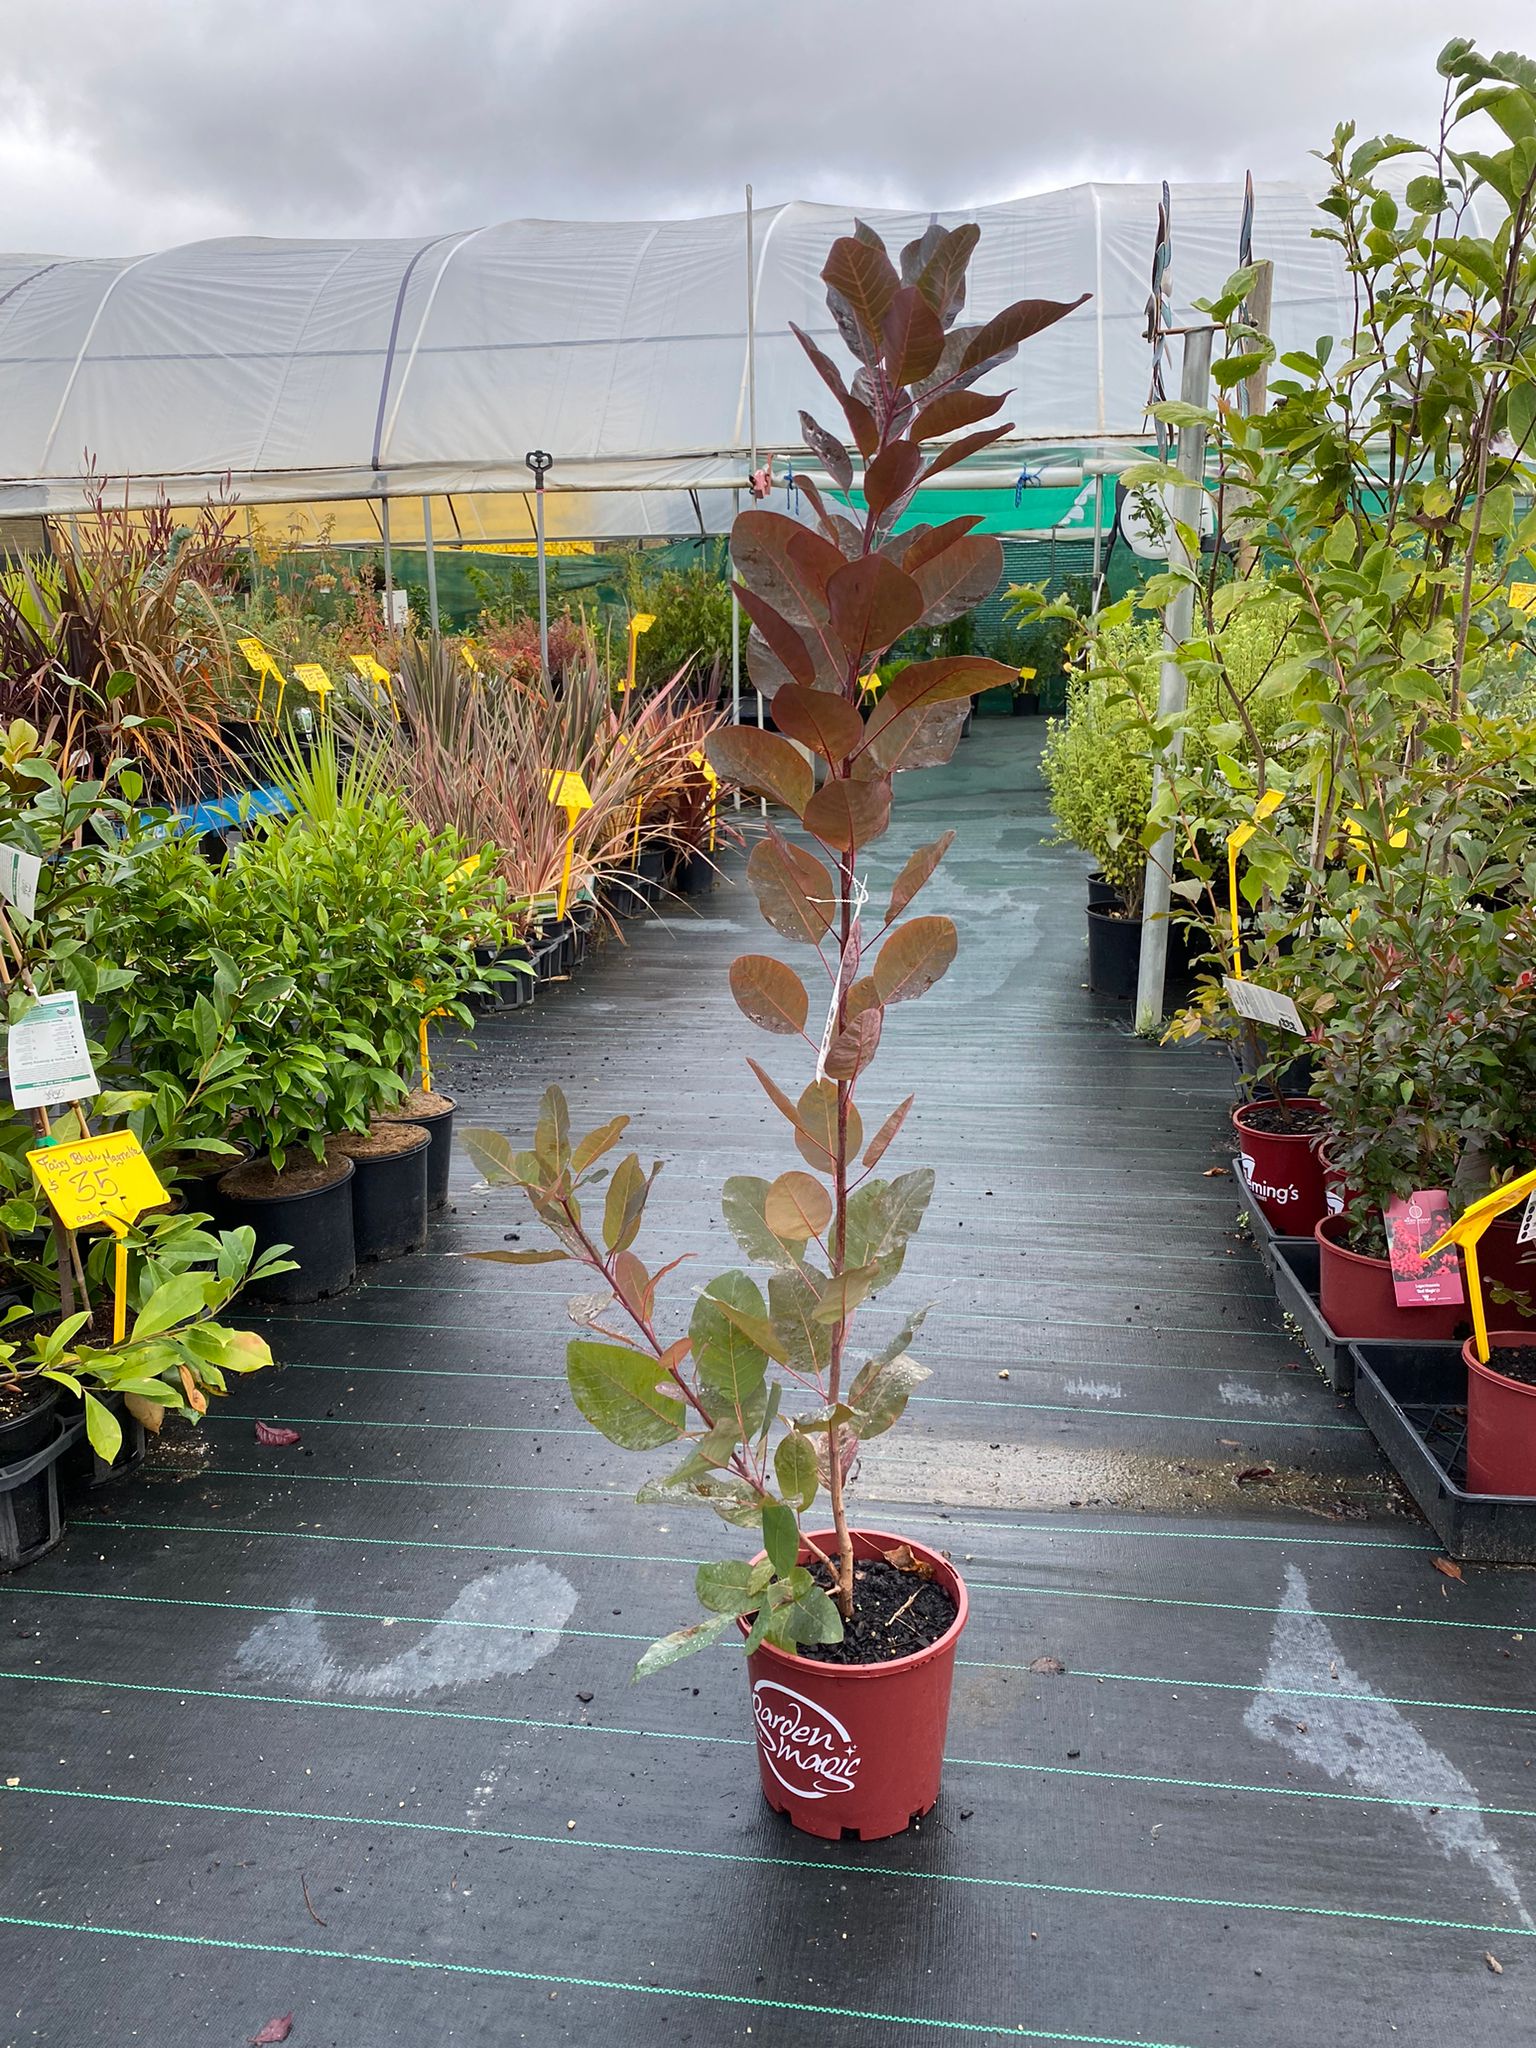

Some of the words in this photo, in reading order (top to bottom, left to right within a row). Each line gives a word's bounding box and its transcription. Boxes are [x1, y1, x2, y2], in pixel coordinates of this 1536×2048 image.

[36, 1154, 71, 1176] Fairy
[70, 1150, 100, 1165] Blush
[68, 1167, 118, 1202] 35
